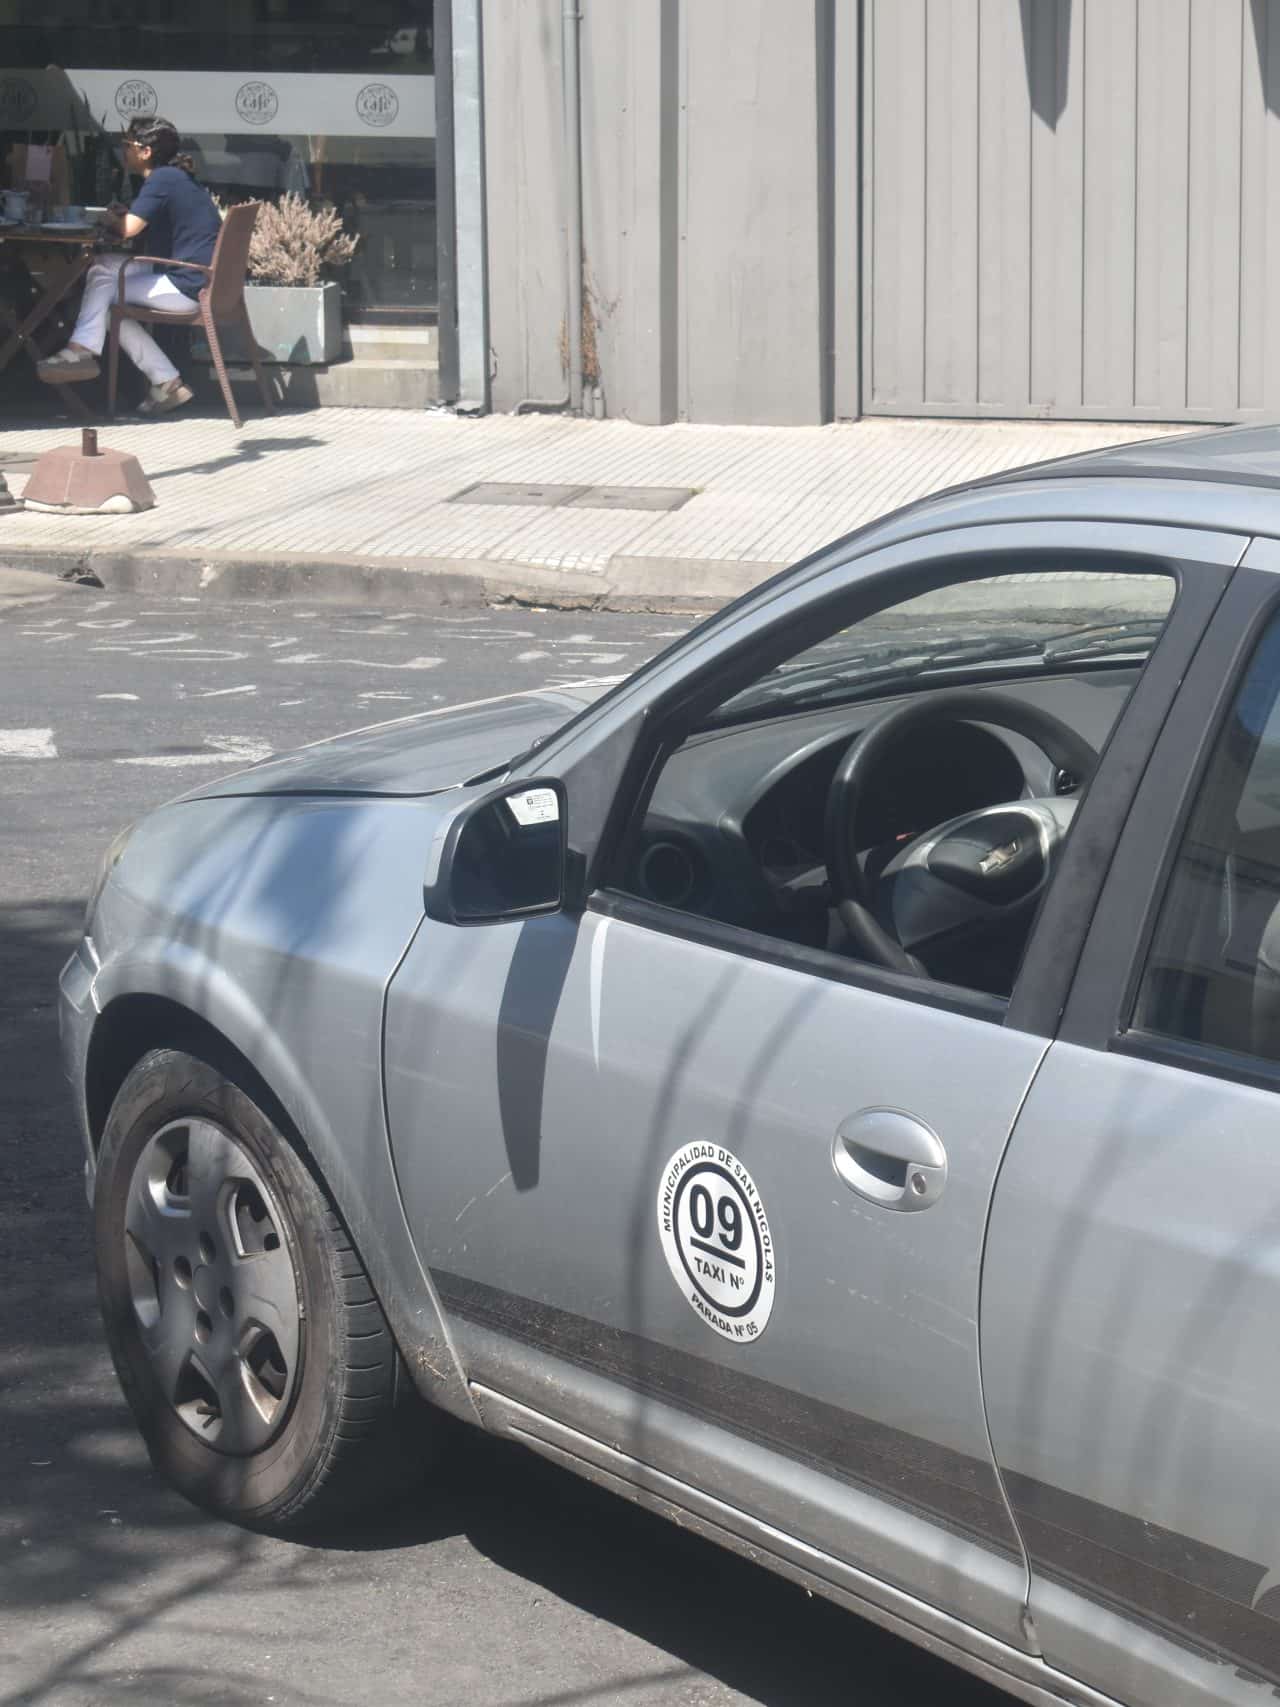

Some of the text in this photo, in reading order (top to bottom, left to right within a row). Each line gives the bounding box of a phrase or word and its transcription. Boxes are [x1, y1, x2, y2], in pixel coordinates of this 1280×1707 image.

[663, 1145, 773, 1283] MUNICIPALIDAD DE SAN NICOLAS
[689, 1184, 743, 1251] 09
[694, 1257, 726, 1284] TAXI
[691, 1293, 733, 1336] PARADA
[747, 1321, 759, 1336] 05
